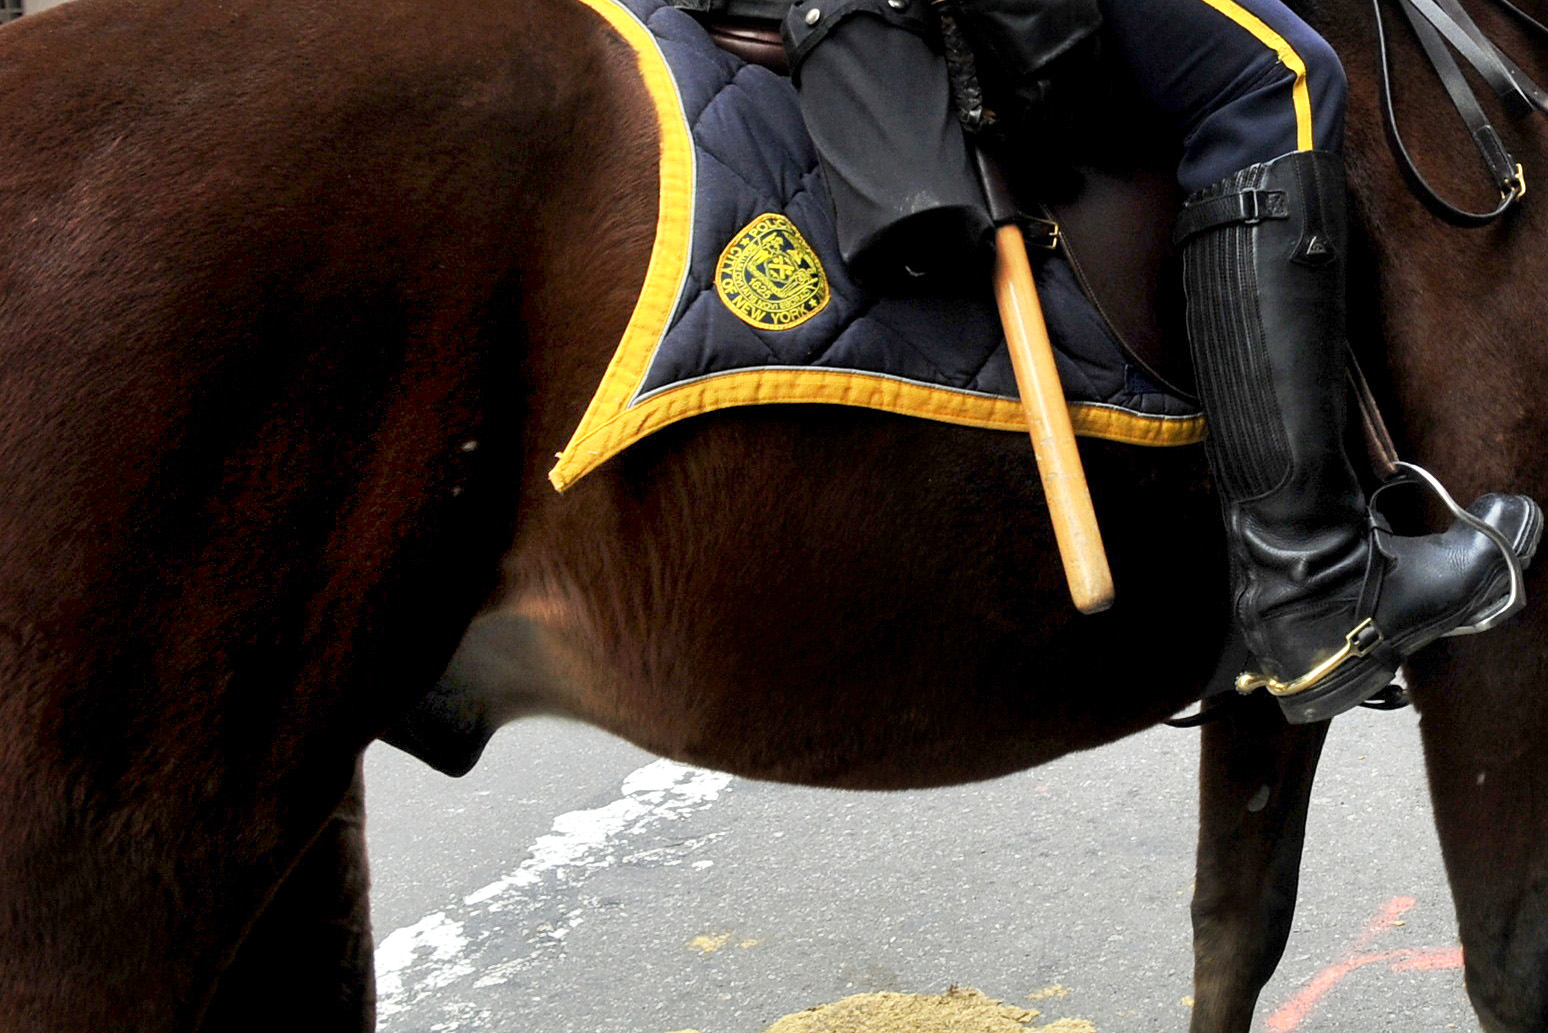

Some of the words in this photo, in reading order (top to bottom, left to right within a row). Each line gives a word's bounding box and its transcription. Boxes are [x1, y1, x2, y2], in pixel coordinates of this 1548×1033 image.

[721, 246, 743, 274] CITY
[722, 278, 738, 295] OF
[748, 278, 773, 299] 1625
[732, 294, 767, 322] NEW
[771, 303, 809, 325] YORK
